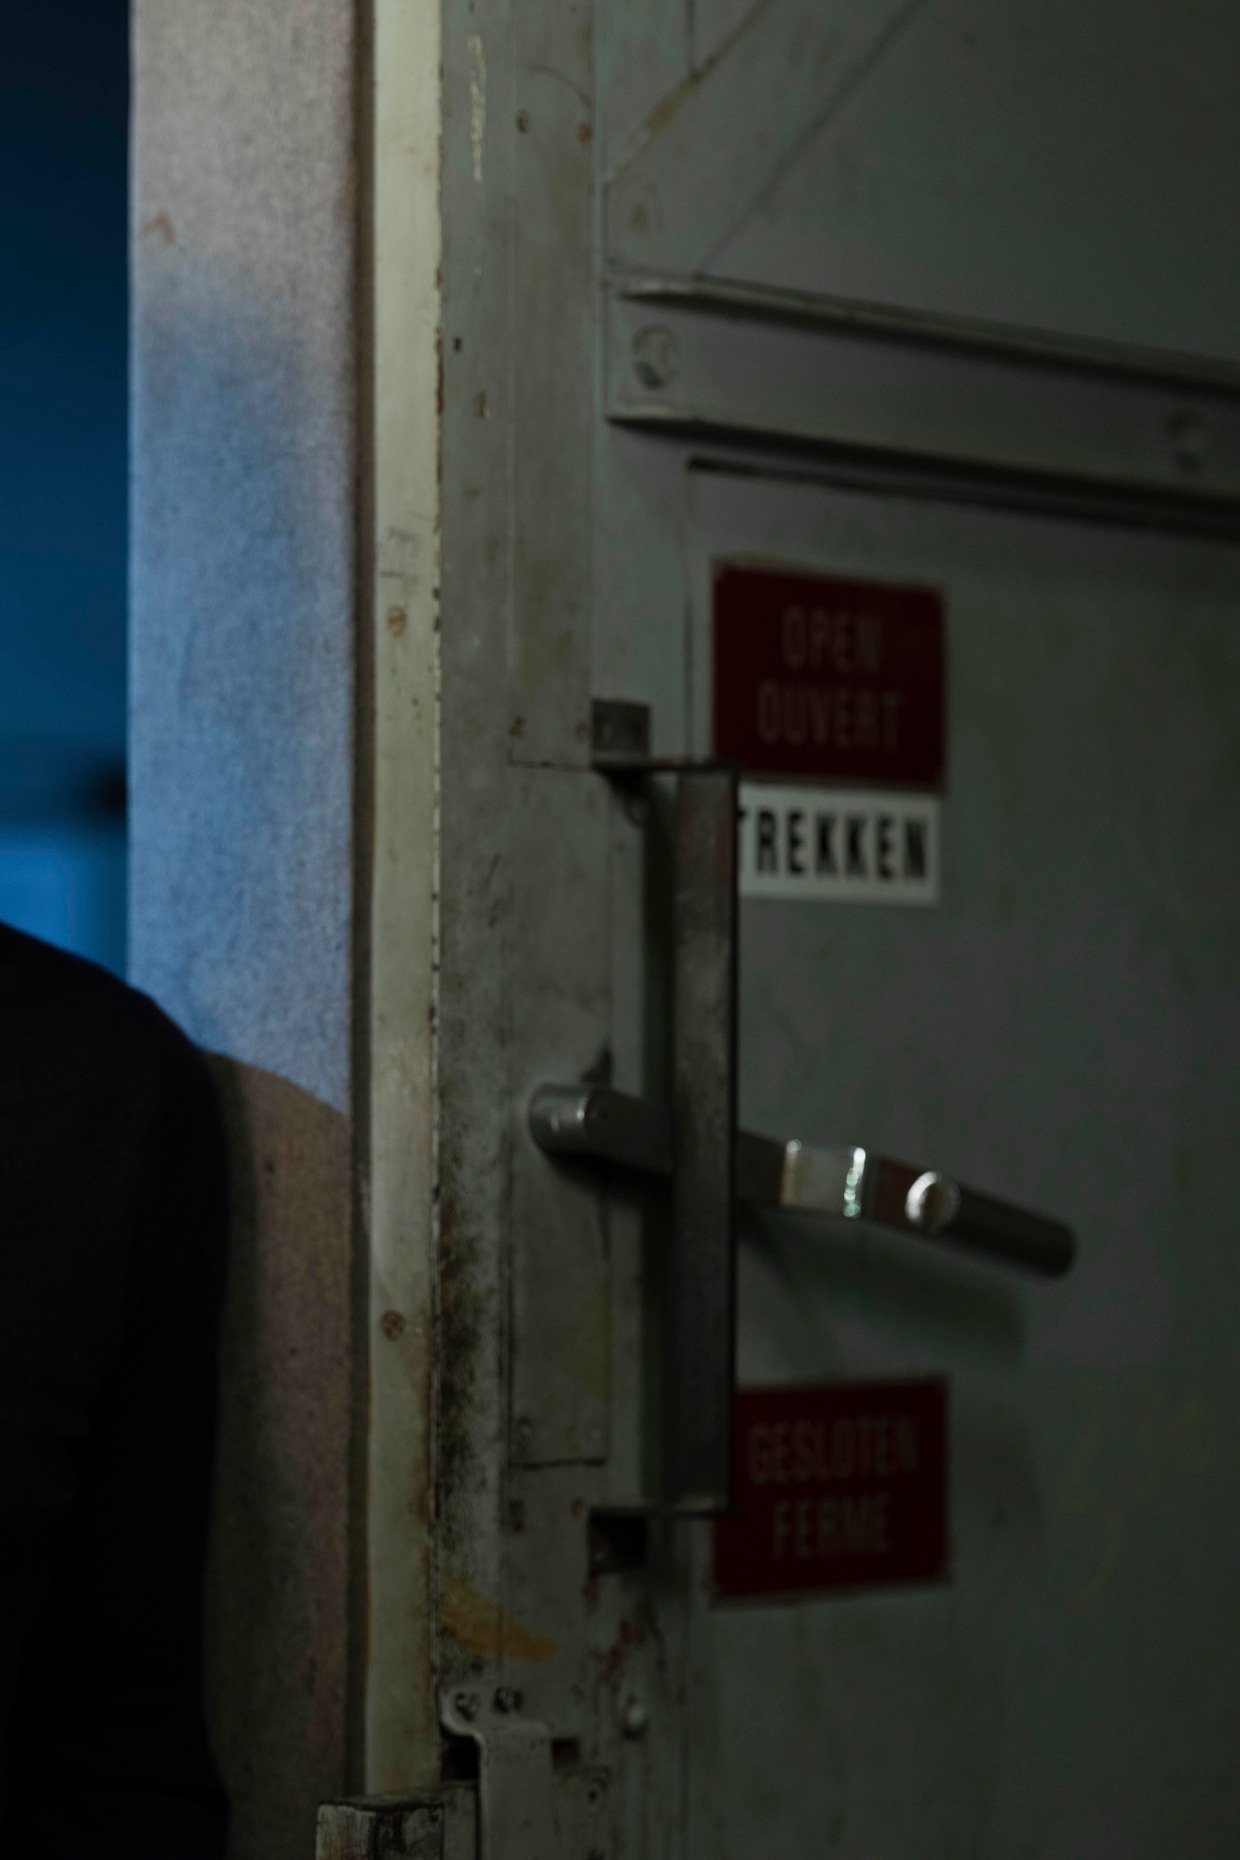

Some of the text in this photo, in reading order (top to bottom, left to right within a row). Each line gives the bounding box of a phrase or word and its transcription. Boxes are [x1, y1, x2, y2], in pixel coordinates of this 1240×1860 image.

[781, 603, 882, 674] OPEN
[756, 679, 902, 751] OUVERT
[738, 805, 929, 881] REKKEN
[747, 1414, 920, 1486] GESLOTEN
